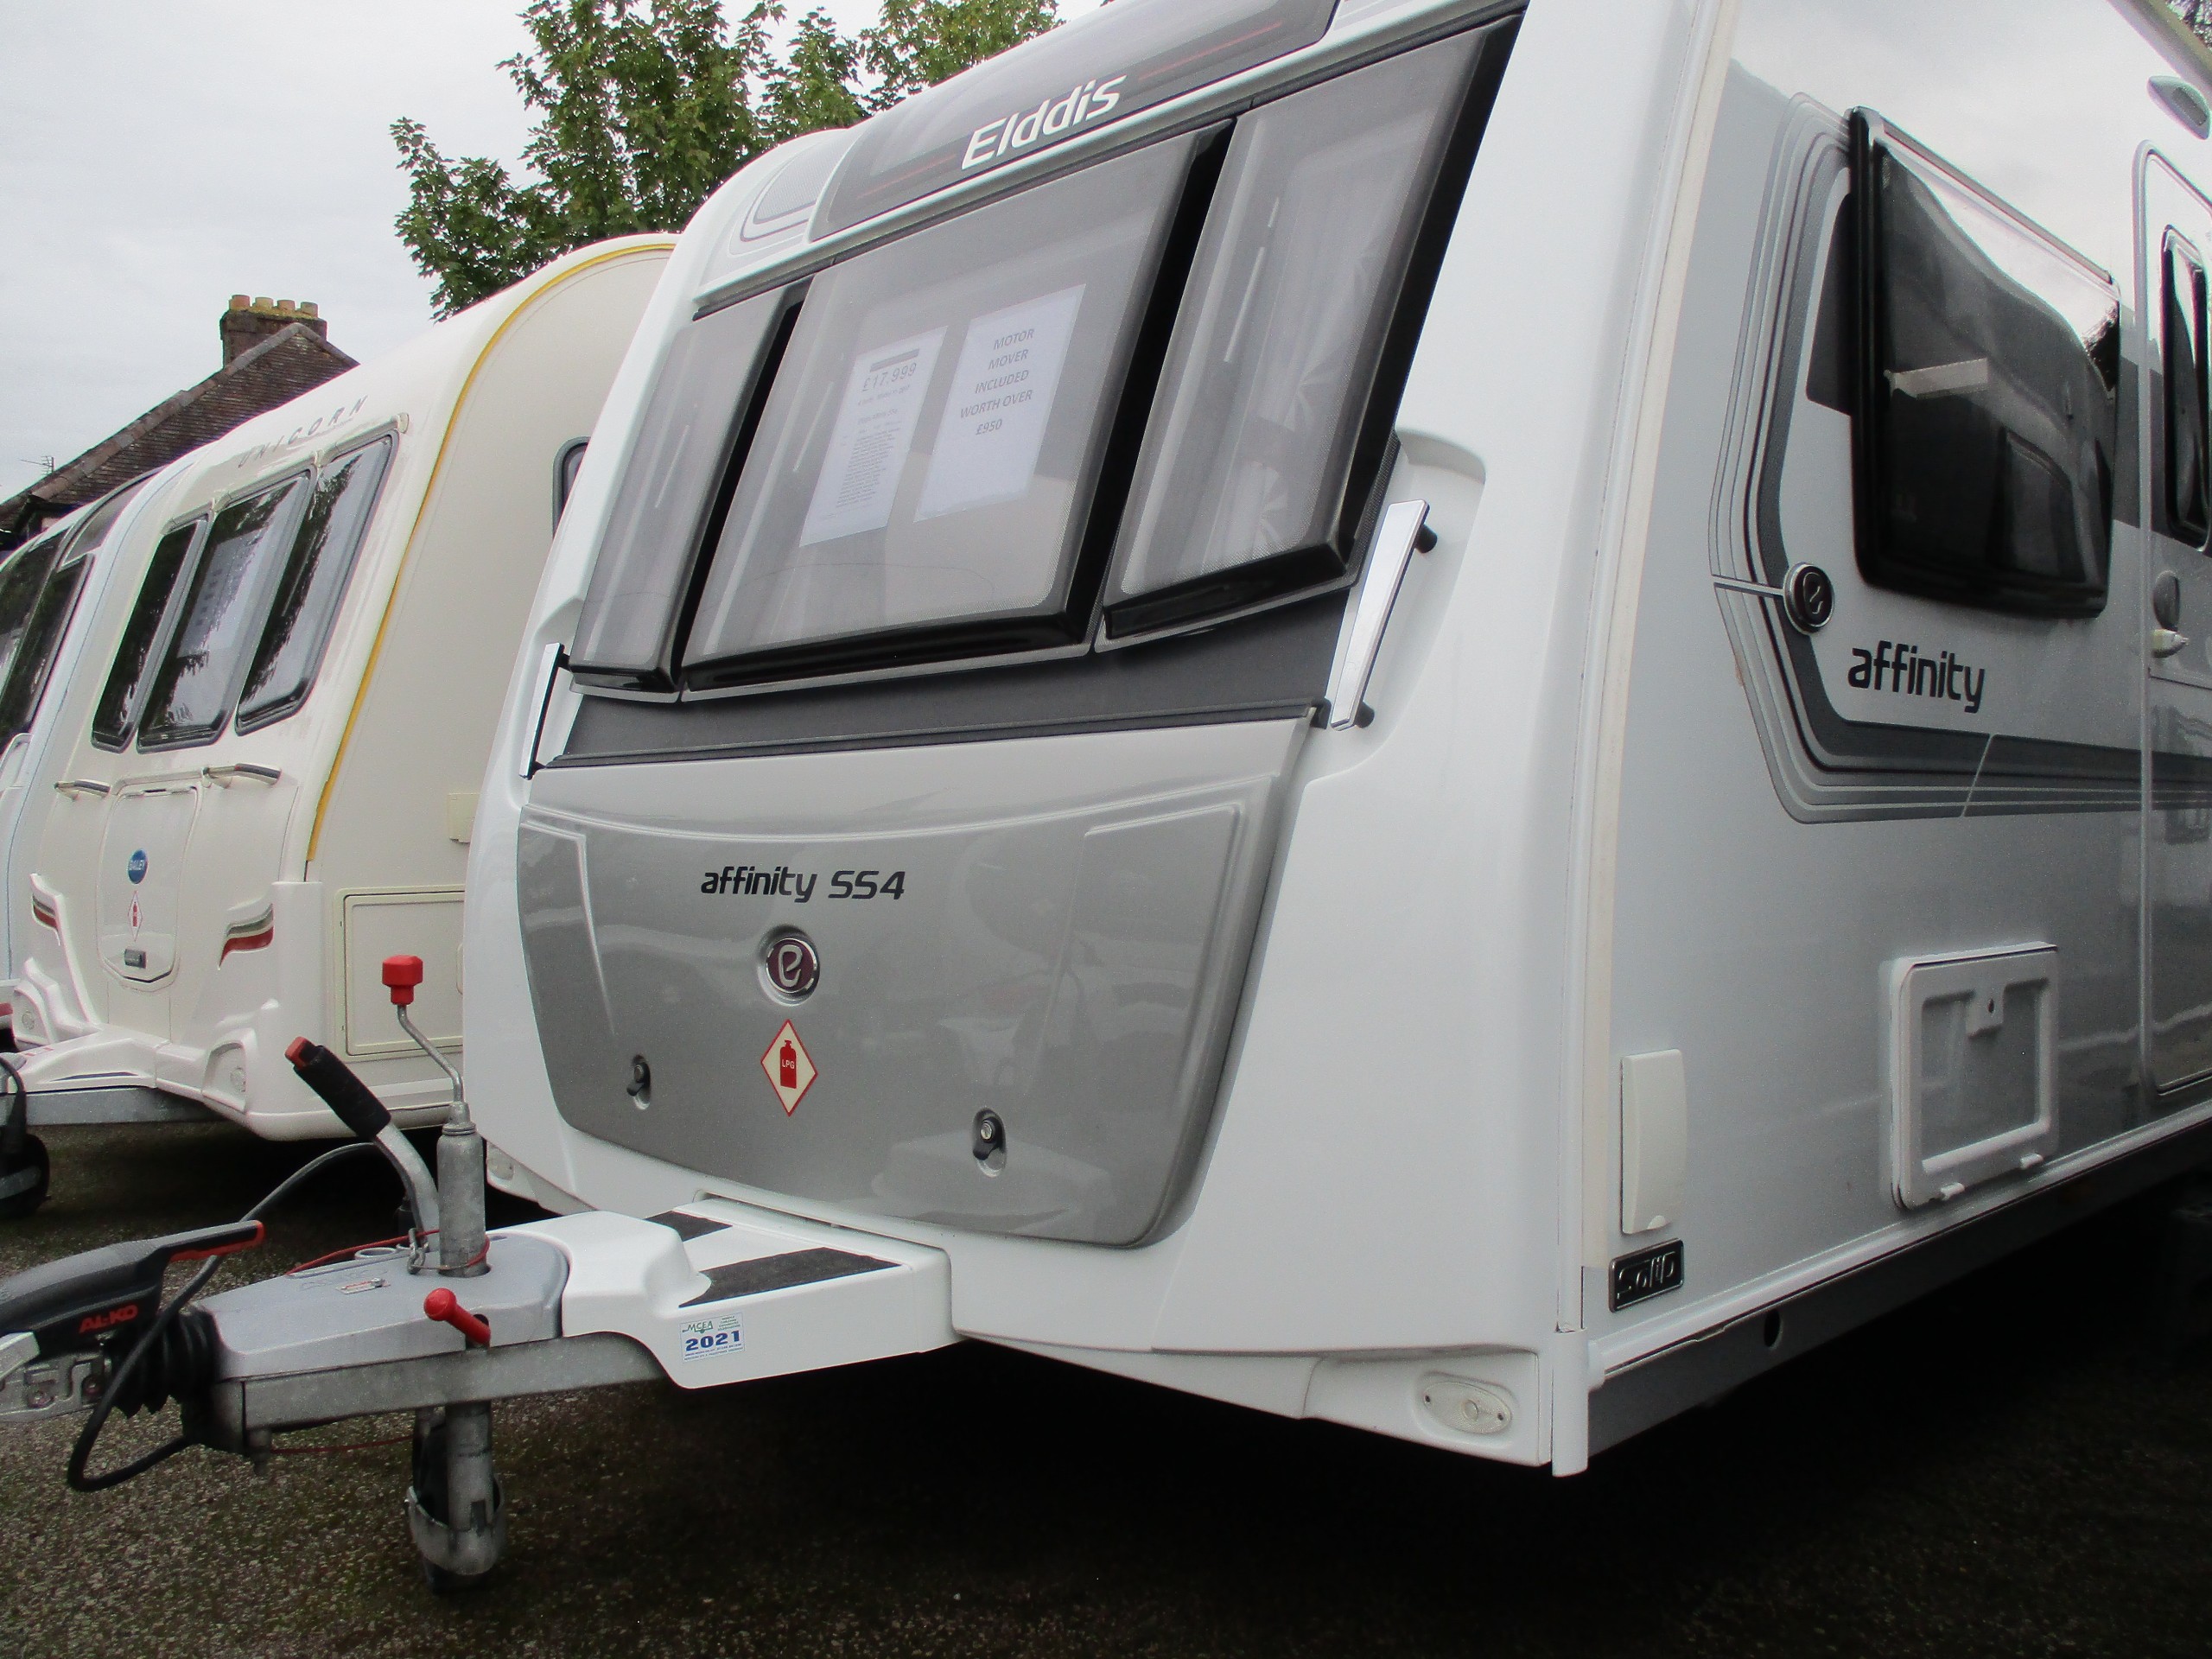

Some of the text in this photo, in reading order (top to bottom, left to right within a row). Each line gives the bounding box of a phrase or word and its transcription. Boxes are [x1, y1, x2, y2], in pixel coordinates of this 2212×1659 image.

[961, 74, 1128, 170] Elddis
[993, 328, 1035, 350] MOTOR
[988, 348, 1029, 371] MOVER
[974, 369, 1030, 394] INCLUDED
[960, 389, 1033, 419] WORTH OVER
[238, 394, 369, 468] UNICORN
[975, 418, 1003, 435] £950
[1847, 639, 1986, 715] affinity
[701, 866, 818, 904] affinity
[781, 1058, 795, 1070] LPG
[688, 1320, 714, 1332] MCEA
[685, 1331, 740, 1351] 2021
